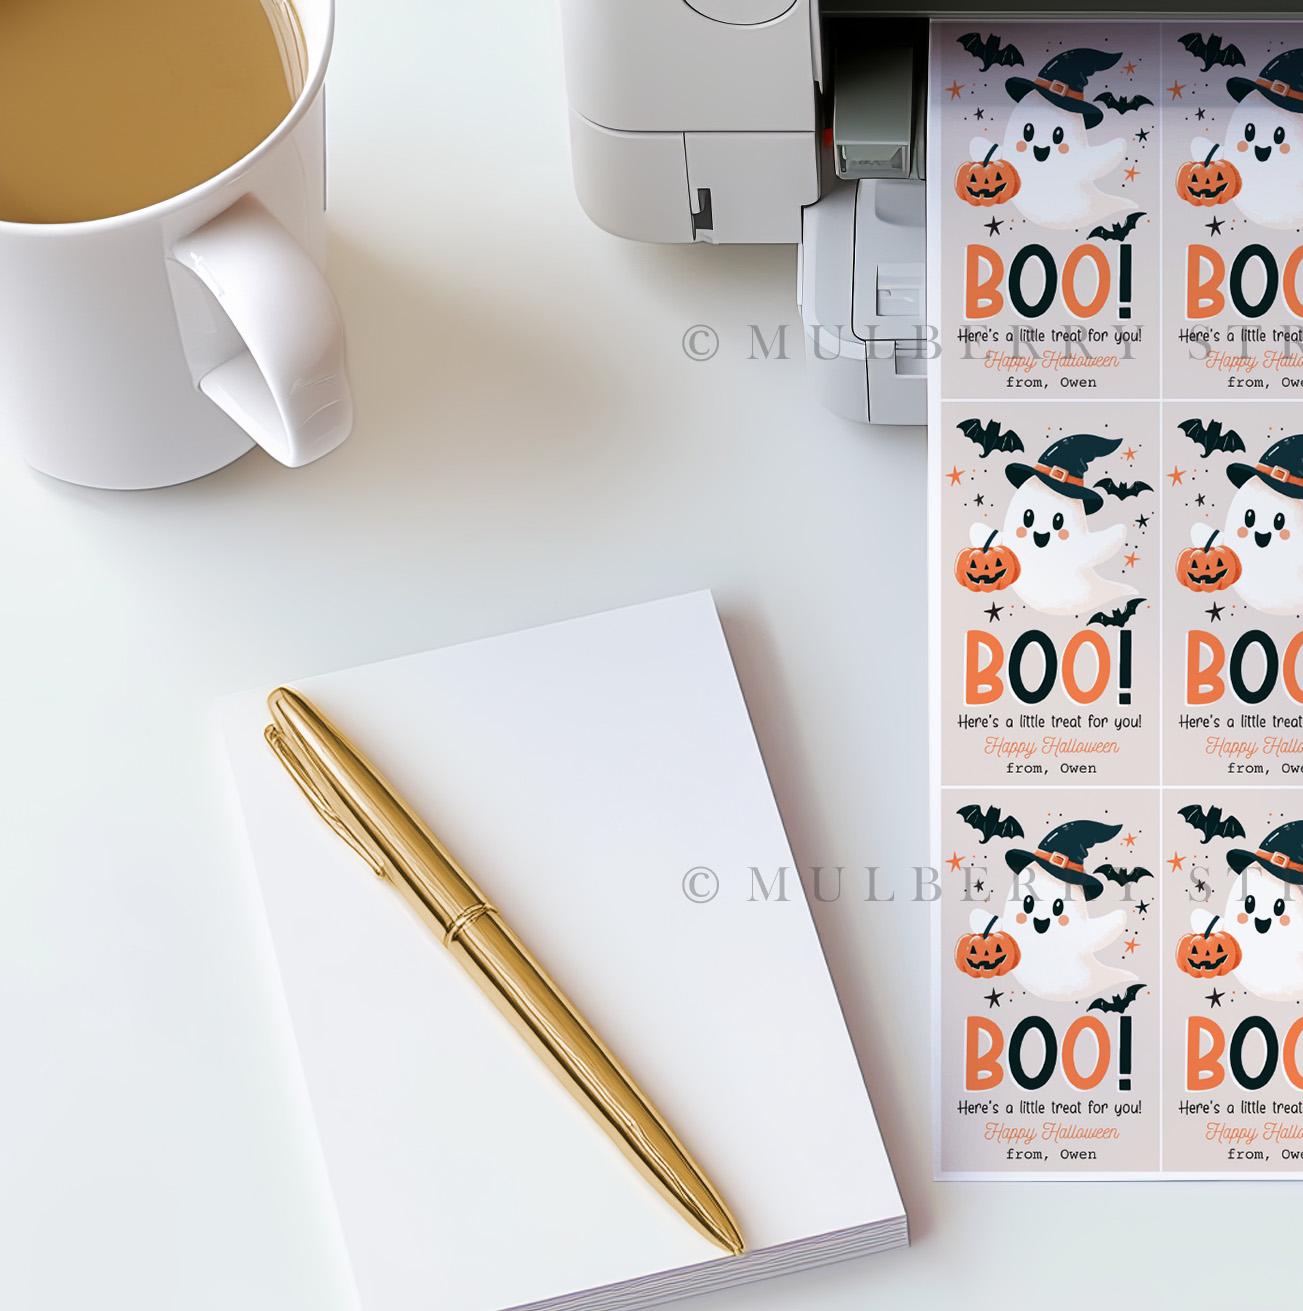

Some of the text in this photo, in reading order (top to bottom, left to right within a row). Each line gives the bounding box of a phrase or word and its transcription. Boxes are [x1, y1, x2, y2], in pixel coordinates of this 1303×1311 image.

[965, 243, 1132, 319] BOO!
[957, 328, 1142, 345] Here's a little treat for you!
[1178, 328, 1220, 344] Here's
[1226, 331, 1235, 342] a
[1240, 328, 1266, 342] little
[1272, 328, 1303, 342] treat
[983, 350, 1120, 373] Happy Halloween
[1204, 350, 1258, 373] Happy
[1006, 377, 1097, 389] from, Owen
[1227, 377, 1270, 389] from,
[965, 629, 1132, 705] BOO!
[957, 714, 1142, 731] Here's a little treat for you!
[1178, 714, 1220, 730] Here's
[1226, 717, 1235, 728] a
[1240, 714, 1266, 728] little
[1272, 714, 1303, 728] treat
[983, 736, 1120, 759] Happy Halloween
[1204, 736, 1258, 759] Happy
[1006, 763, 1097, 775] from, Owen
[1227, 763, 1270, 775] from,
[965, 1015, 1132, 1091] BOO!
[957, 1100, 1142, 1117] Here's a little treat for you!
[1178, 1100, 1220, 1116] Here's
[1226, 1103, 1235, 1114] a
[1240, 1100, 1266, 1114] little
[1272, 1100, 1303, 1114] treat
[983, 1122, 1120, 1145] Happy Halloween
[1204, 1122, 1258, 1145] Happy
[1006, 1149, 1097, 1161] from, Owen
[1227, 1149, 1270, 1161] from,
